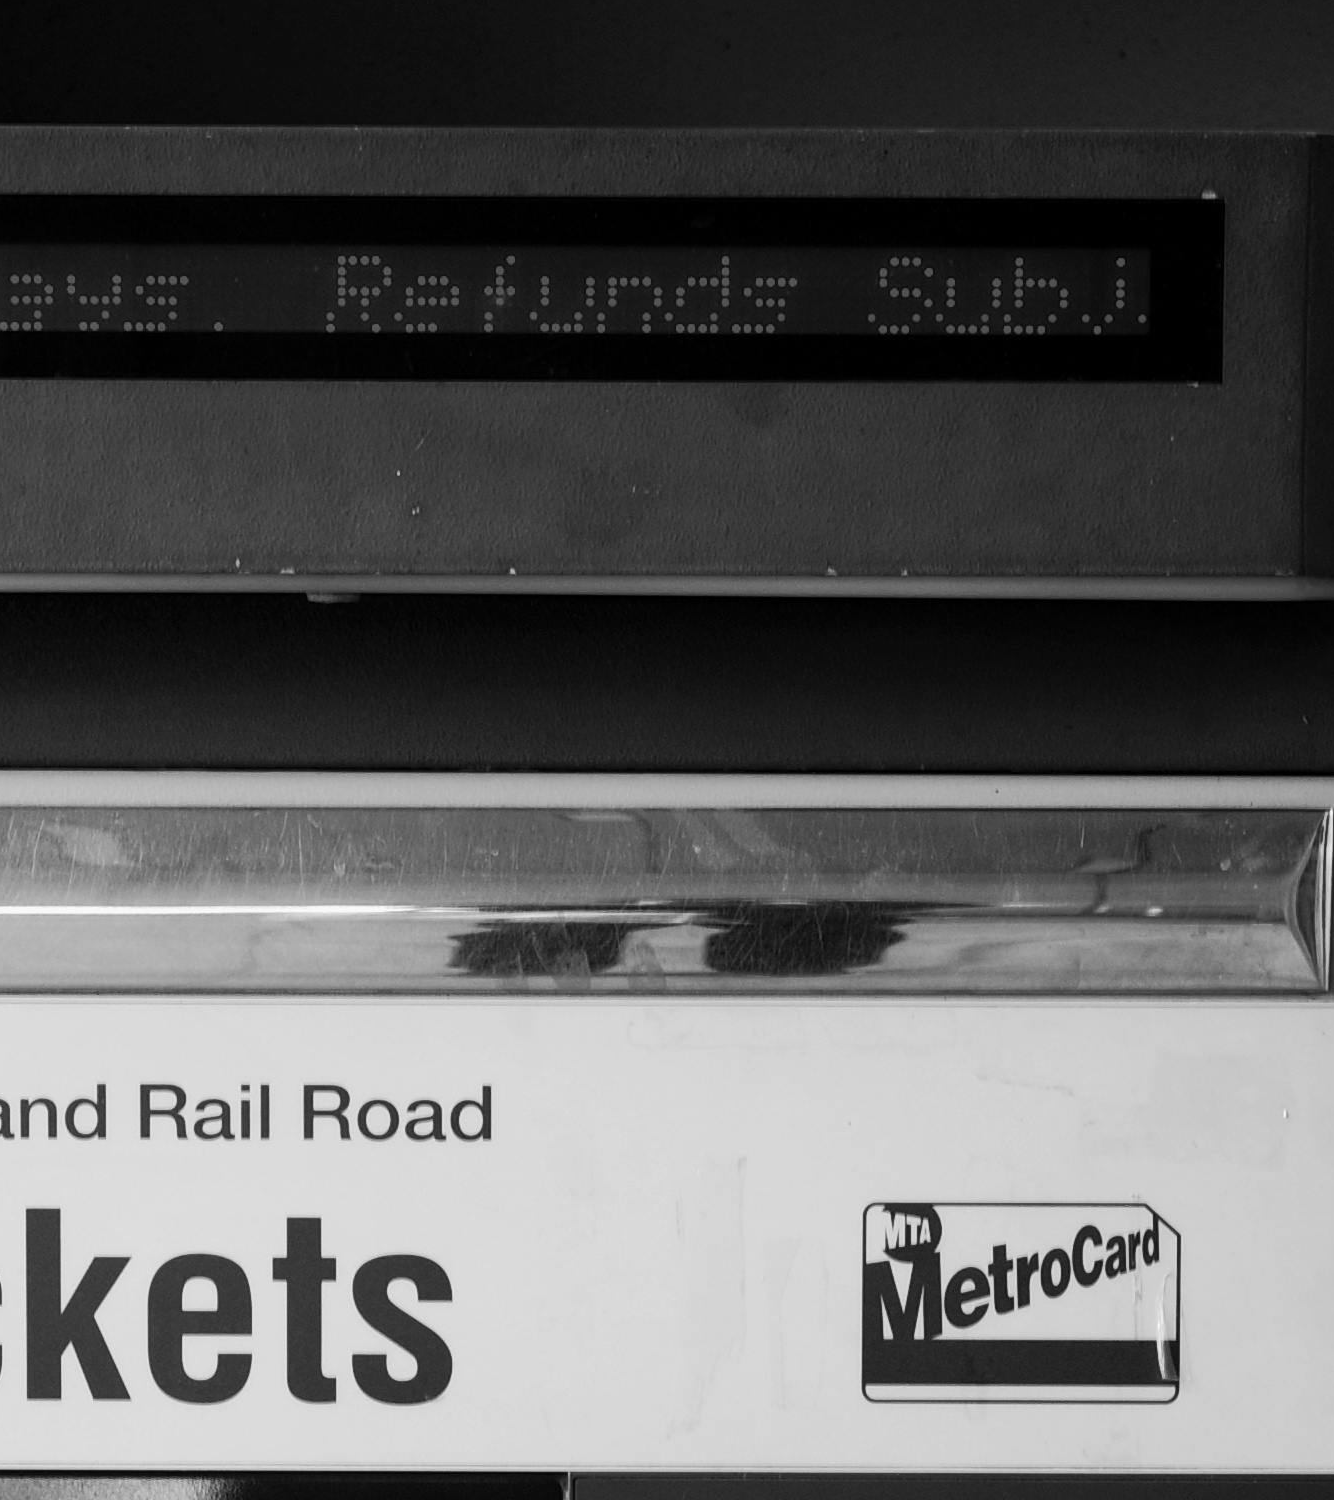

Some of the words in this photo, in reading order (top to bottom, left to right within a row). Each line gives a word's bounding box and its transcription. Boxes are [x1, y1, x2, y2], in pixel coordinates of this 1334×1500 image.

[325, 254, 798, 334] Refunds
[140, 1084, 269, 1139] Rail
[304, 1084, 492, 1141] Road
[883, 1209, 931, 1251] MTA
[866, 1213, 1159, 1340] MetroCard
